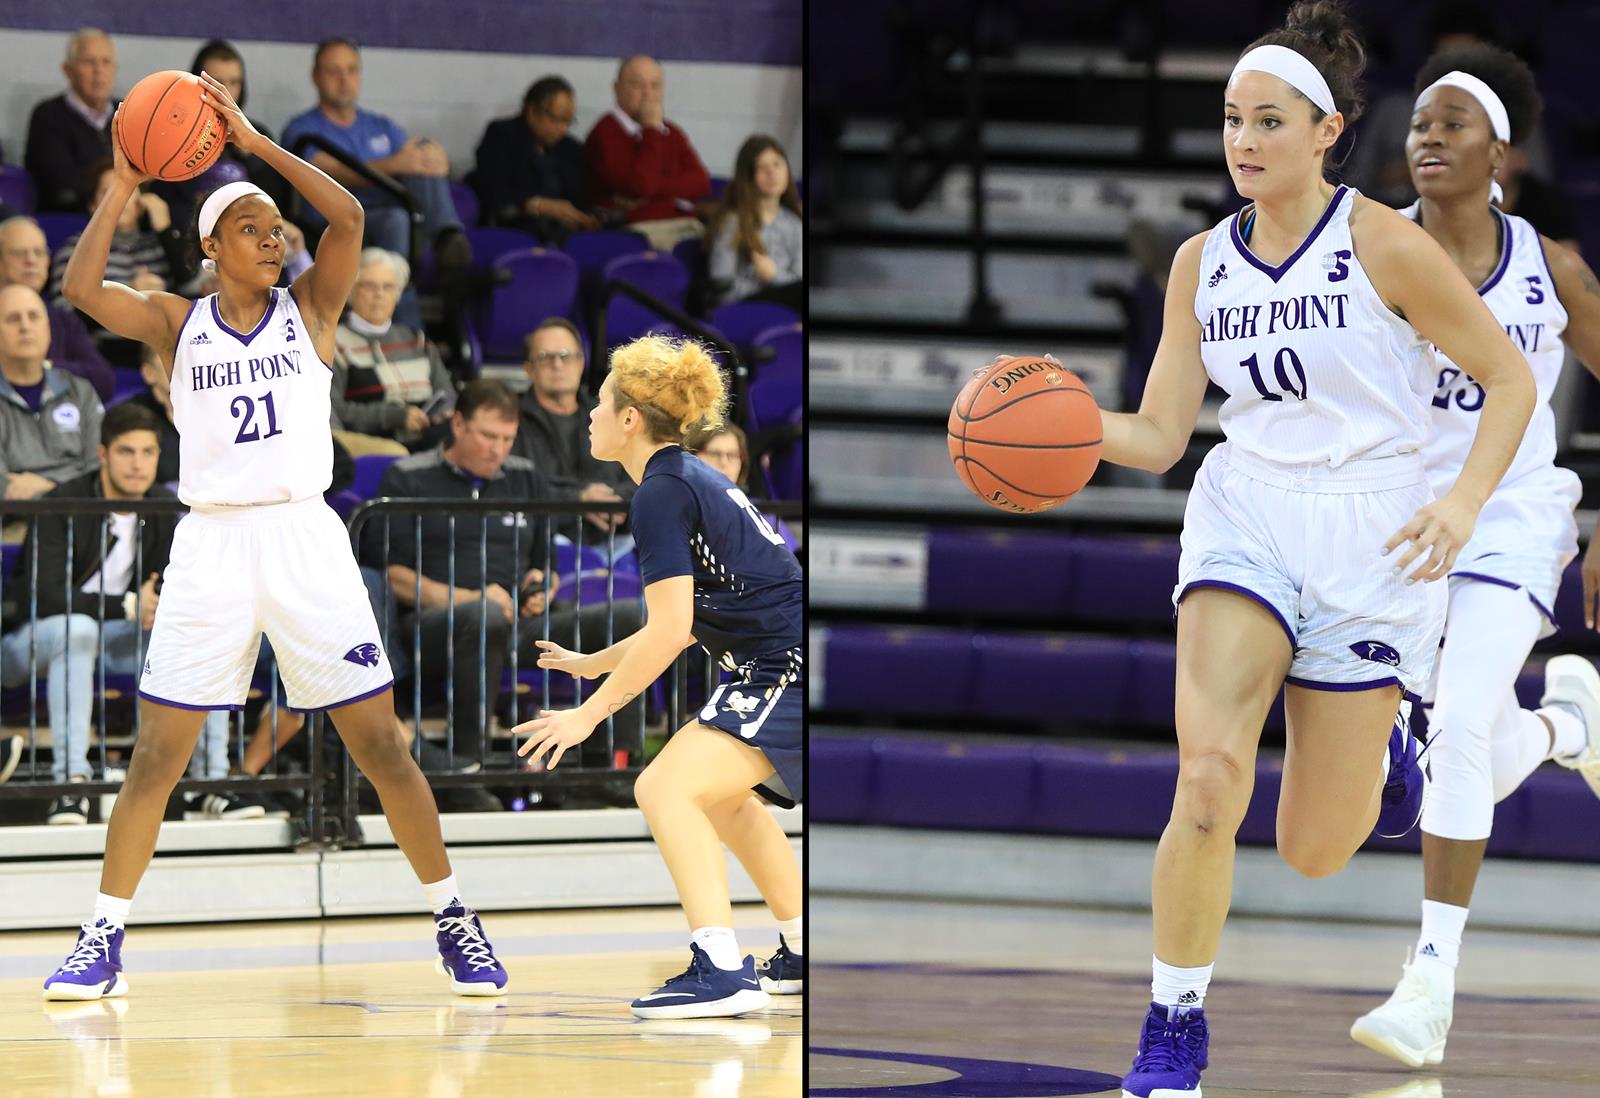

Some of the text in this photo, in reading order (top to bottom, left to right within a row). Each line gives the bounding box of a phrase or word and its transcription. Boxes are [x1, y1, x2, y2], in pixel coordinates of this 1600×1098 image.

[1267, 294, 1349, 334] POINT
[192, 350, 301, 391] HIGH POINT
[1240, 347, 1307, 401] 10
[230, 391, 282, 444] 21
